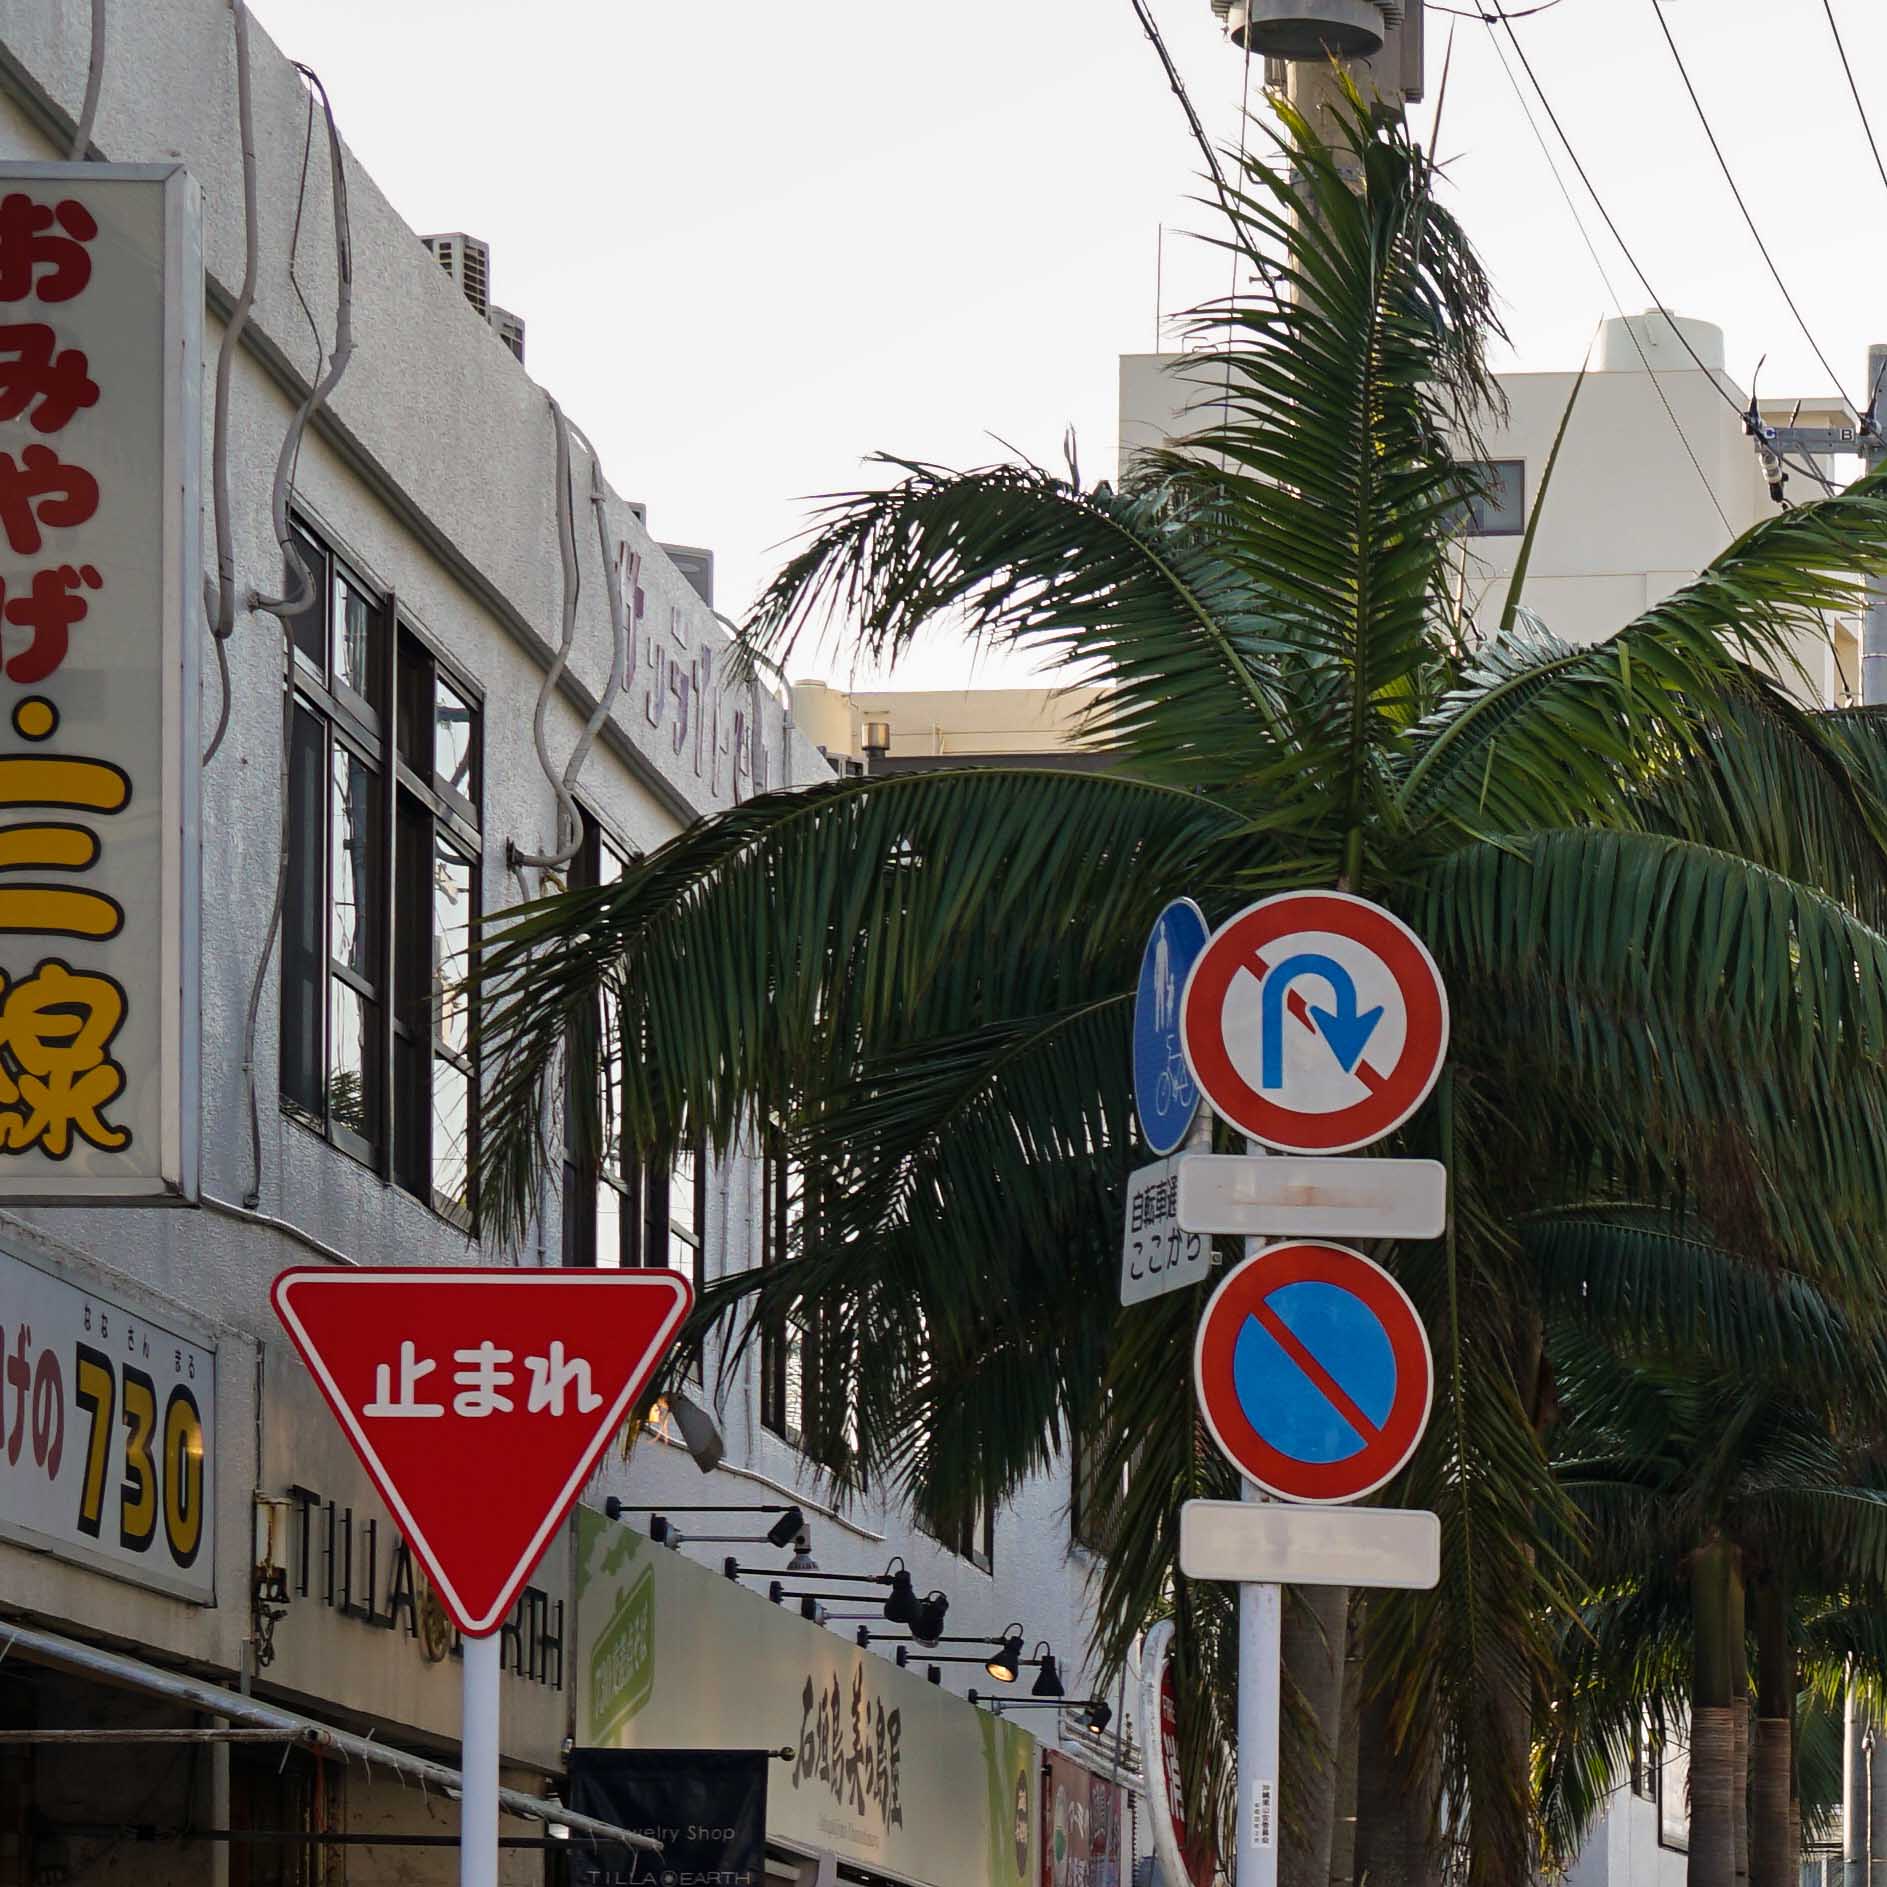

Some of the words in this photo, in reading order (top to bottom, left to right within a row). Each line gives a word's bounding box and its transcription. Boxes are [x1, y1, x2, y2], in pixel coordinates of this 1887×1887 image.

[1131, 1226, 1201, 1281] ここから
[362, 1340, 603, 1417] 止まれ
[76, 1341, 203, 1568] 730
[287, 1484, 419, 1638] TILLA
[687, 1825, 736, 1841] Shop
[586, 1870, 657, 1886] TILLA
[680, 1871, 751, 1887] EARTH
